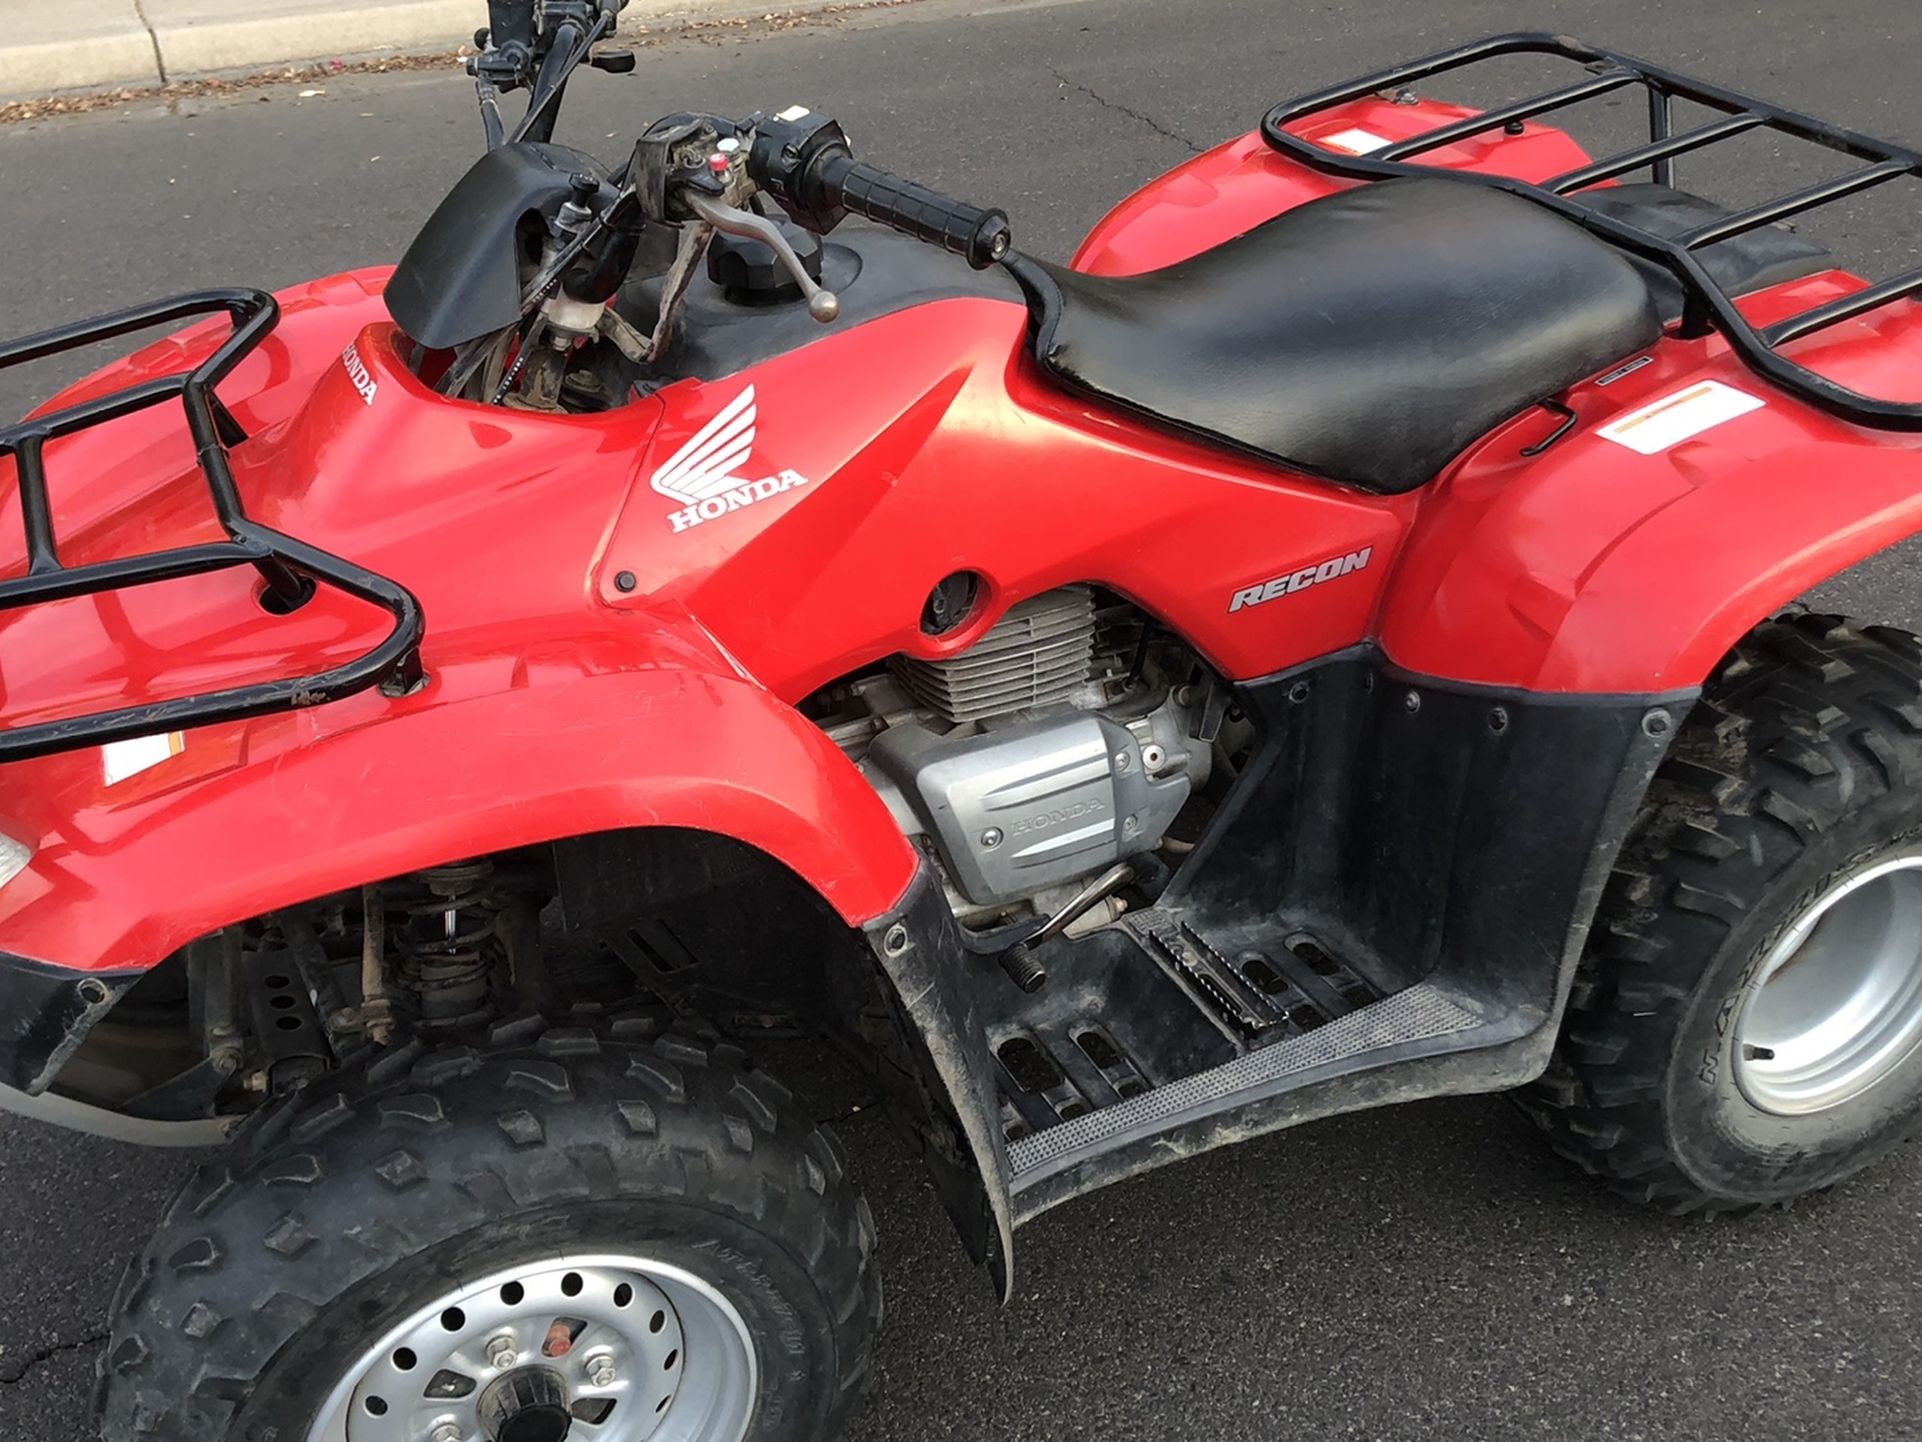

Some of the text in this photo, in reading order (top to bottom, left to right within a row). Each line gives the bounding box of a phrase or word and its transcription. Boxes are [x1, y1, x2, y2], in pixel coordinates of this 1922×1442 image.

[667, 468, 808, 533] HONDA
[1228, 546, 1372, 613] RECON
[1011, 797, 1105, 836] HONDA
